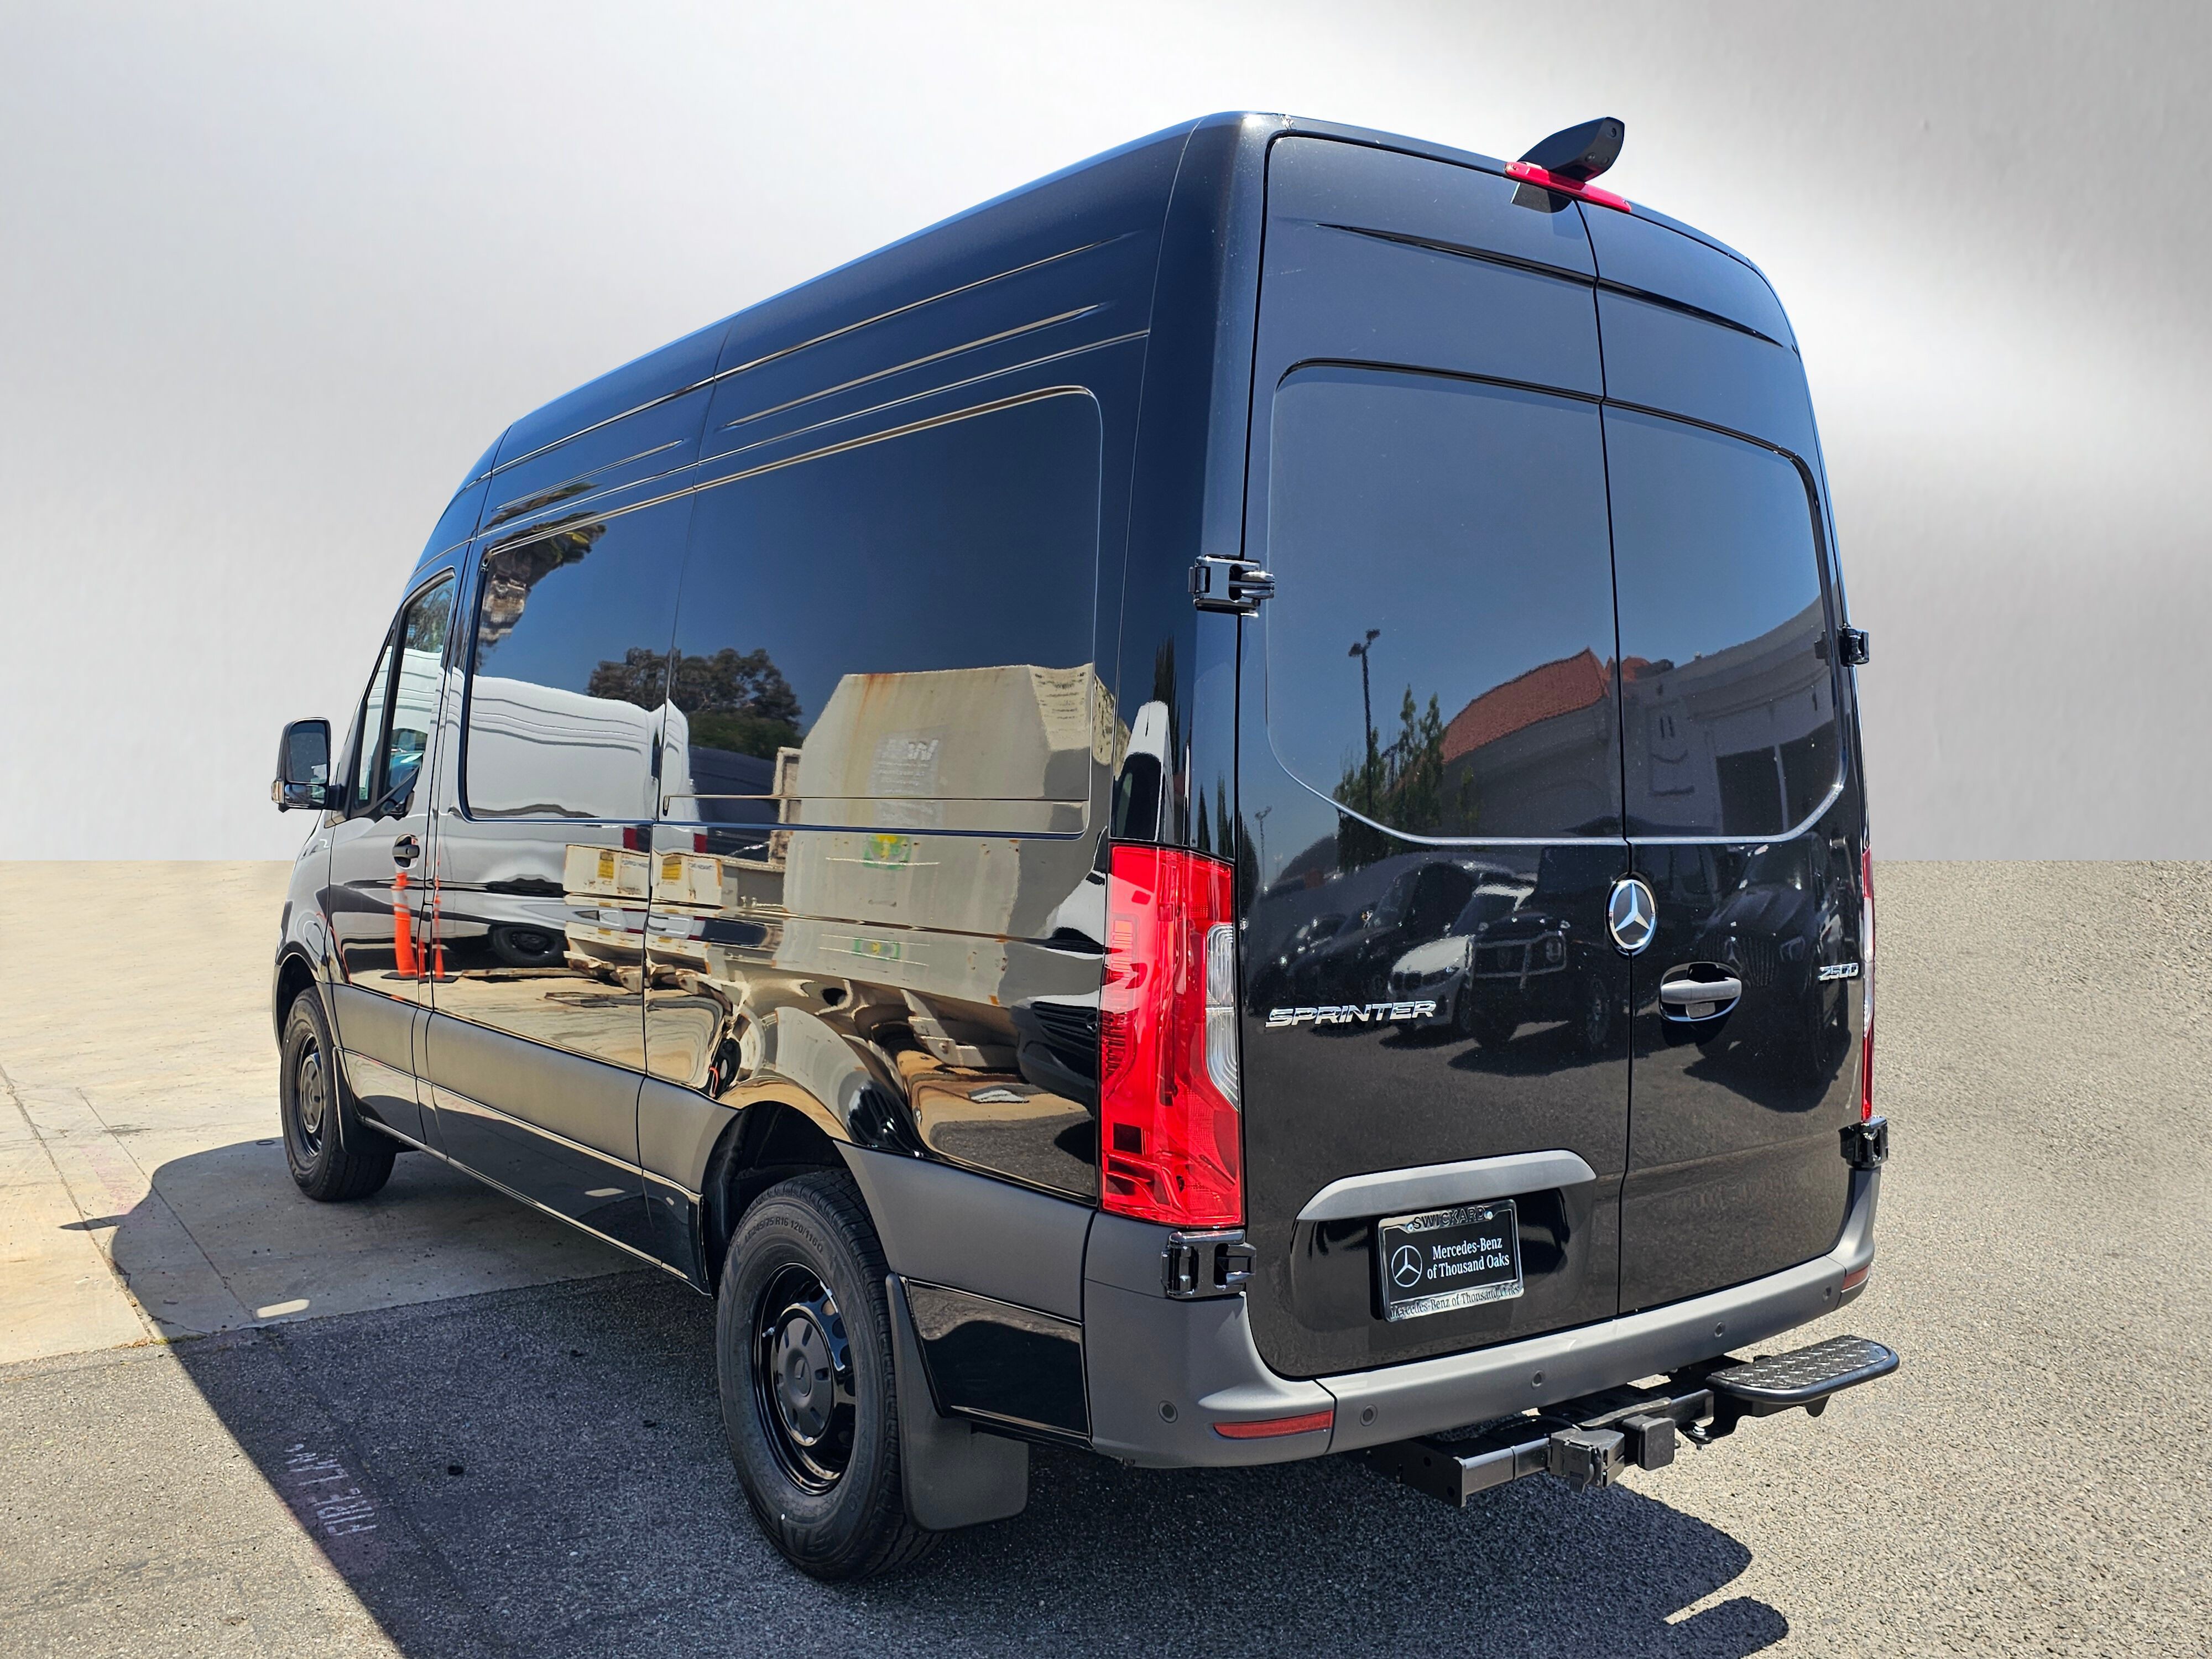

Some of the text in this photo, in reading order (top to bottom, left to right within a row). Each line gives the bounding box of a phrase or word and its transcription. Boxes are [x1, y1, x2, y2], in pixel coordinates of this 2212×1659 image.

[1817, 963, 1859, 981] 2500
[1265, 1000, 1437, 1027] SPRINTER
[775, 1217, 789, 1227] R16
[1413, 1206, 1486, 1229] SWICKARD
[1432, 1238, 1503, 1260] Mercedes-Benz
[1427, 1253, 1510, 1280] of Thousand Oaks
[1390, 1298, 1450, 1319] Mercedes-Benz
[1452, 1294, 1460, 1306] of
